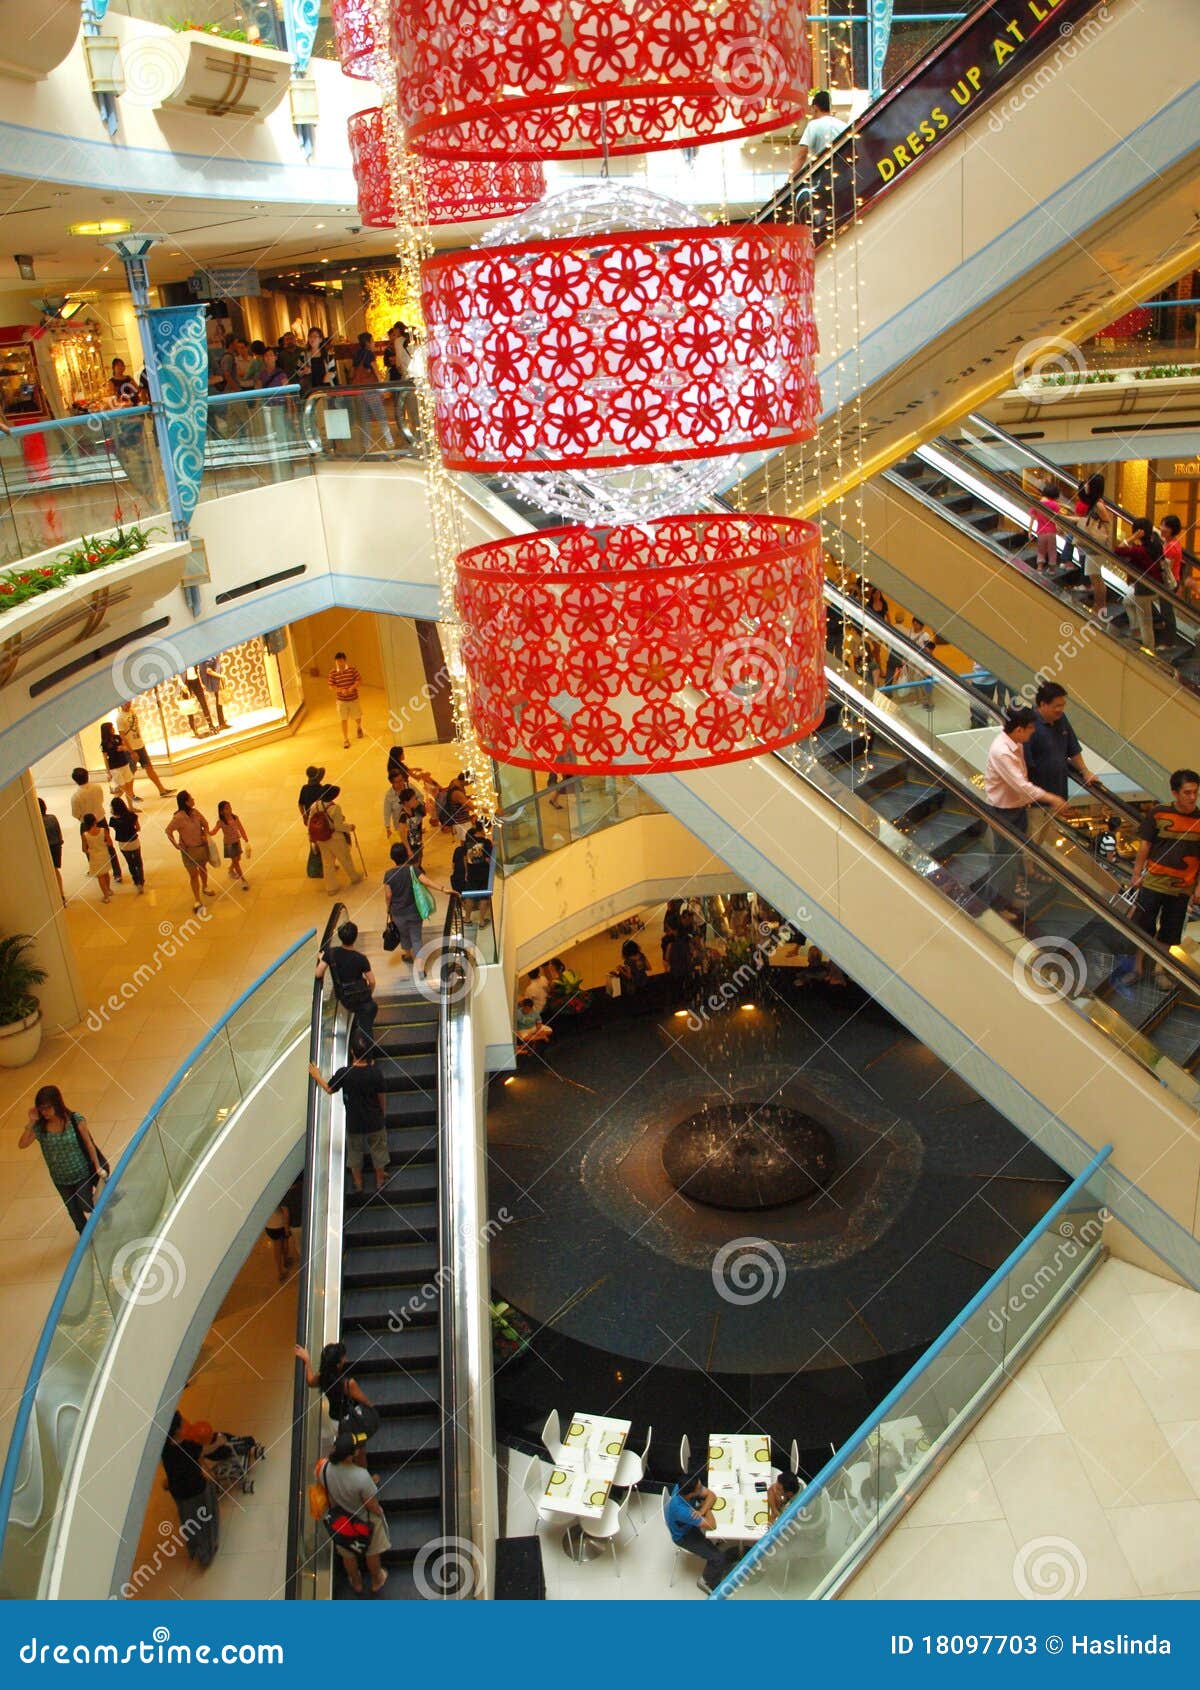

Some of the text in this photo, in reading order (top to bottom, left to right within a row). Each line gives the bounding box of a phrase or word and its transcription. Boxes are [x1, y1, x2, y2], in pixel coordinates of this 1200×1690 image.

[876, 107, 950, 182] DRESS
[950, 66, 983, 106] UP
[992, 19, 1026, 66] AT
